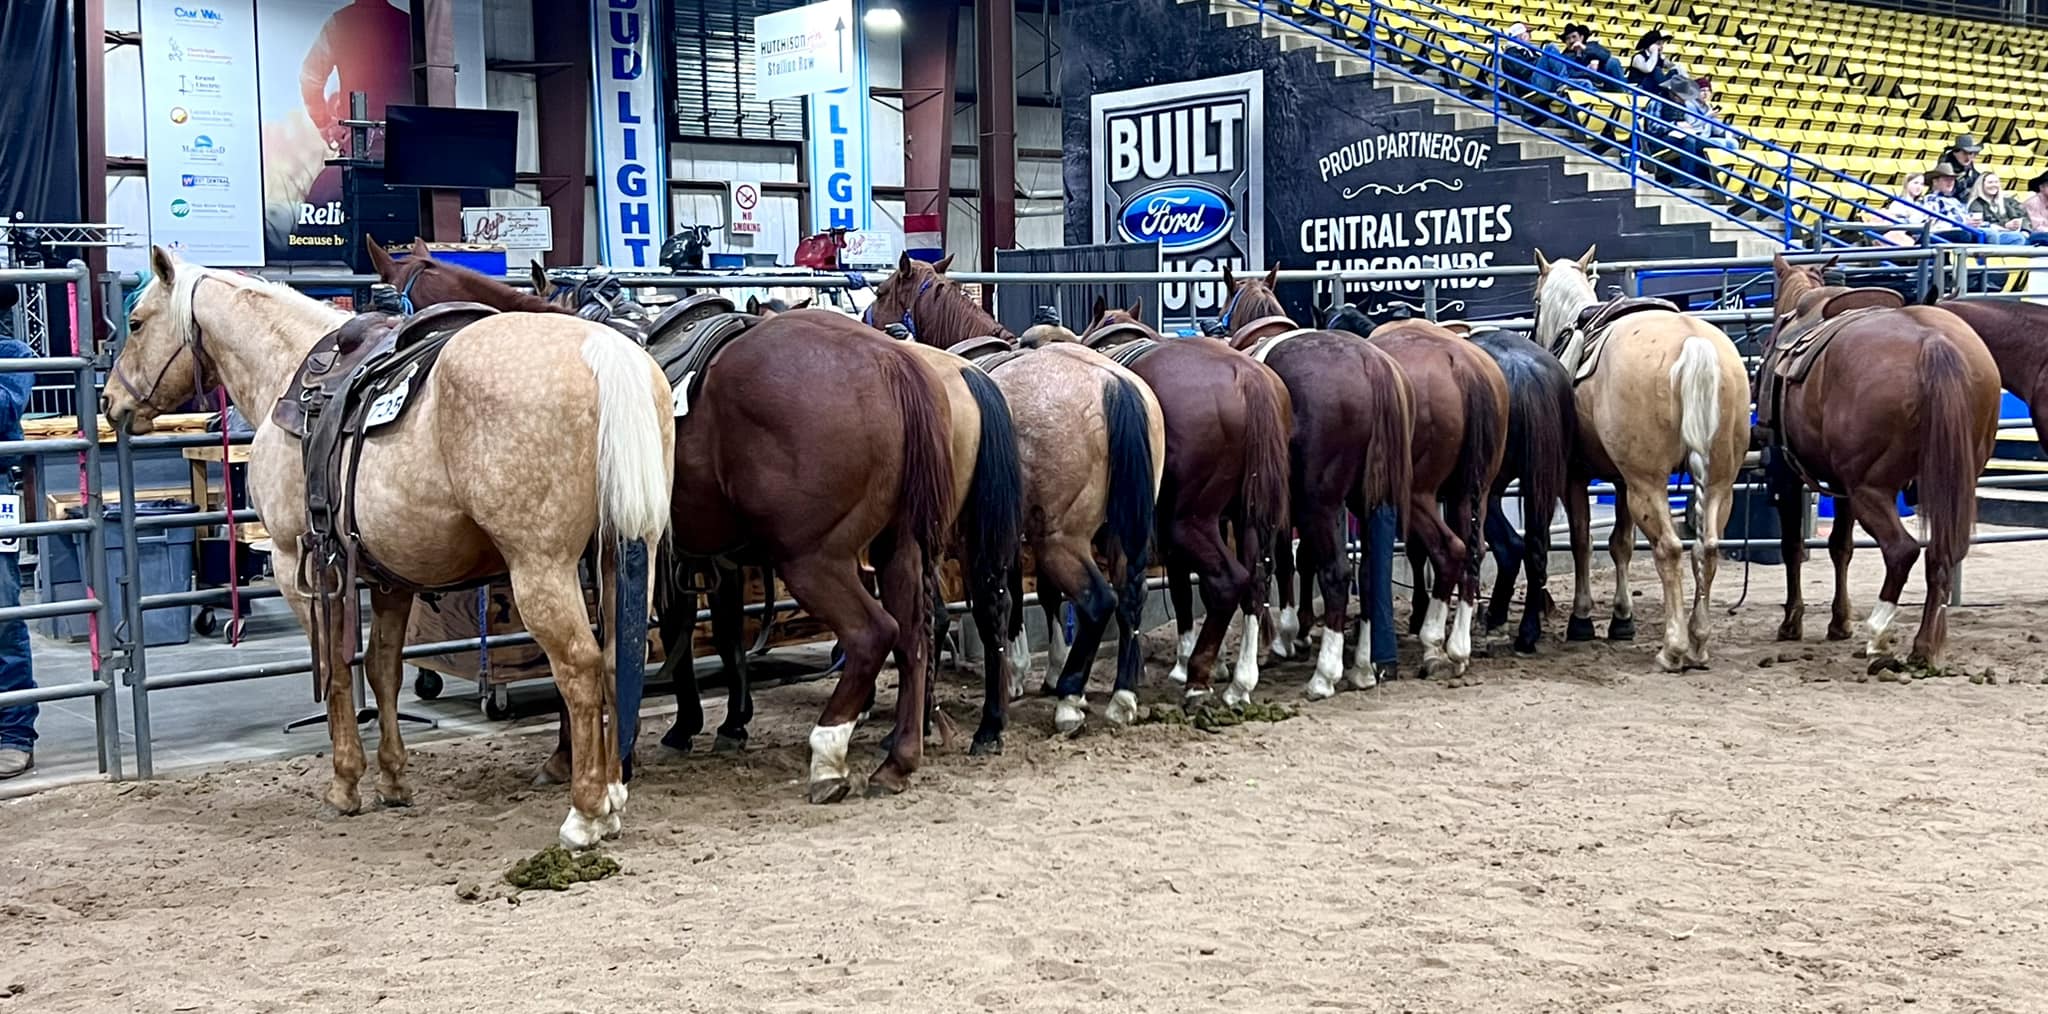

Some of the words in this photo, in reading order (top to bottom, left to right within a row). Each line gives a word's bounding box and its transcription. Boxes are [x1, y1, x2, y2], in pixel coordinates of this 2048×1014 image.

[608, 0, 642, 80] UD
[761, 34, 806, 55] HUTCHISON
[828, 104, 854, 230] LIGH
[1111, 103, 1243, 183] BUILT
[1319, 138, 1374, 182] PROUD
[1377, 131, 1463, 162] PARTNERS
[1463, 140, 1491, 169] OF
[617, 91, 650, 267] LIGHT
[288, 235, 333, 246] Because
[733, 222, 761, 232] SMOKING
[742, 211, 753, 221] NO
[1141, 197, 1206, 235] Ford
[1300, 212, 1410, 253] CENTRAL
[1414, 203, 1513, 246] STATES
